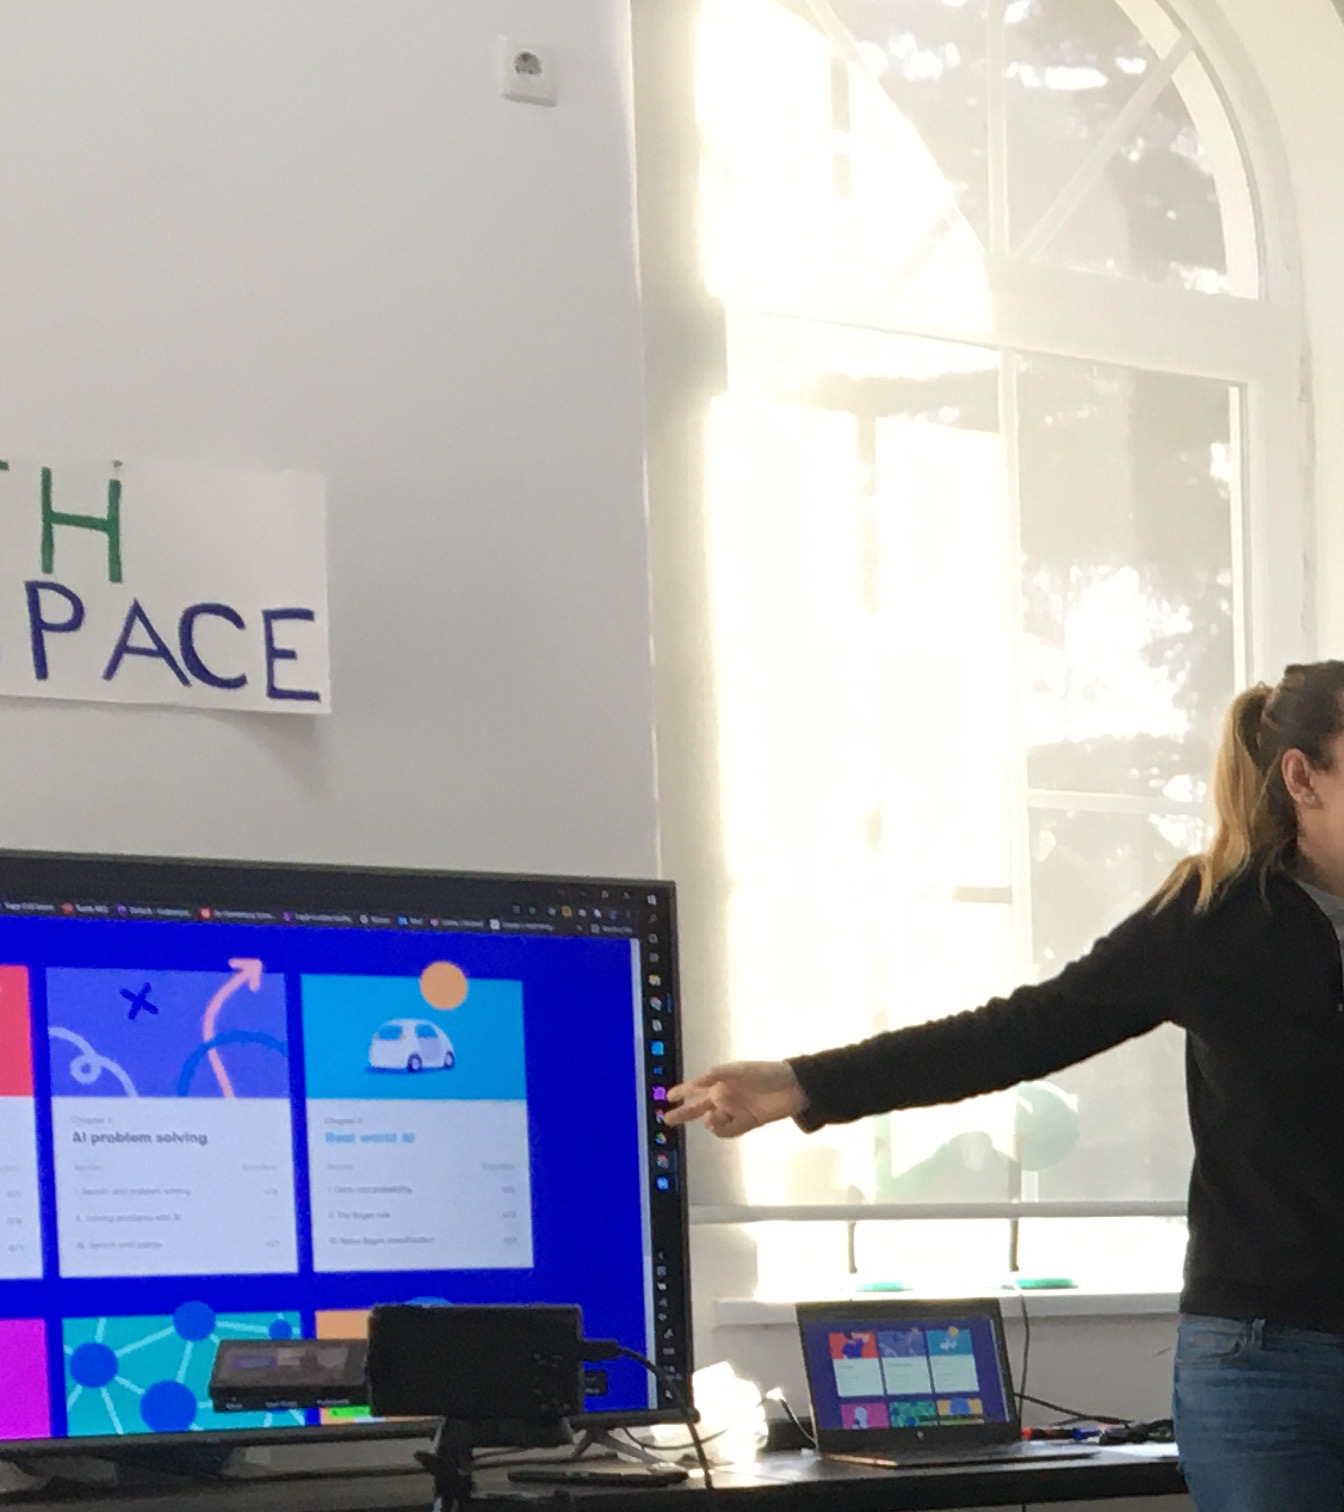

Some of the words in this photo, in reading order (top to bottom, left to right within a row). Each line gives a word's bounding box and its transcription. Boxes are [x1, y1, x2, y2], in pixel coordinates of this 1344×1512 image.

[0, 459, 122, 583] H
[24, 579, 321, 702] PACE
[72, 1131, 87, 1143] AI
[91, 1131, 152, 1145] problem
[156, 1131, 209, 1146] solving
